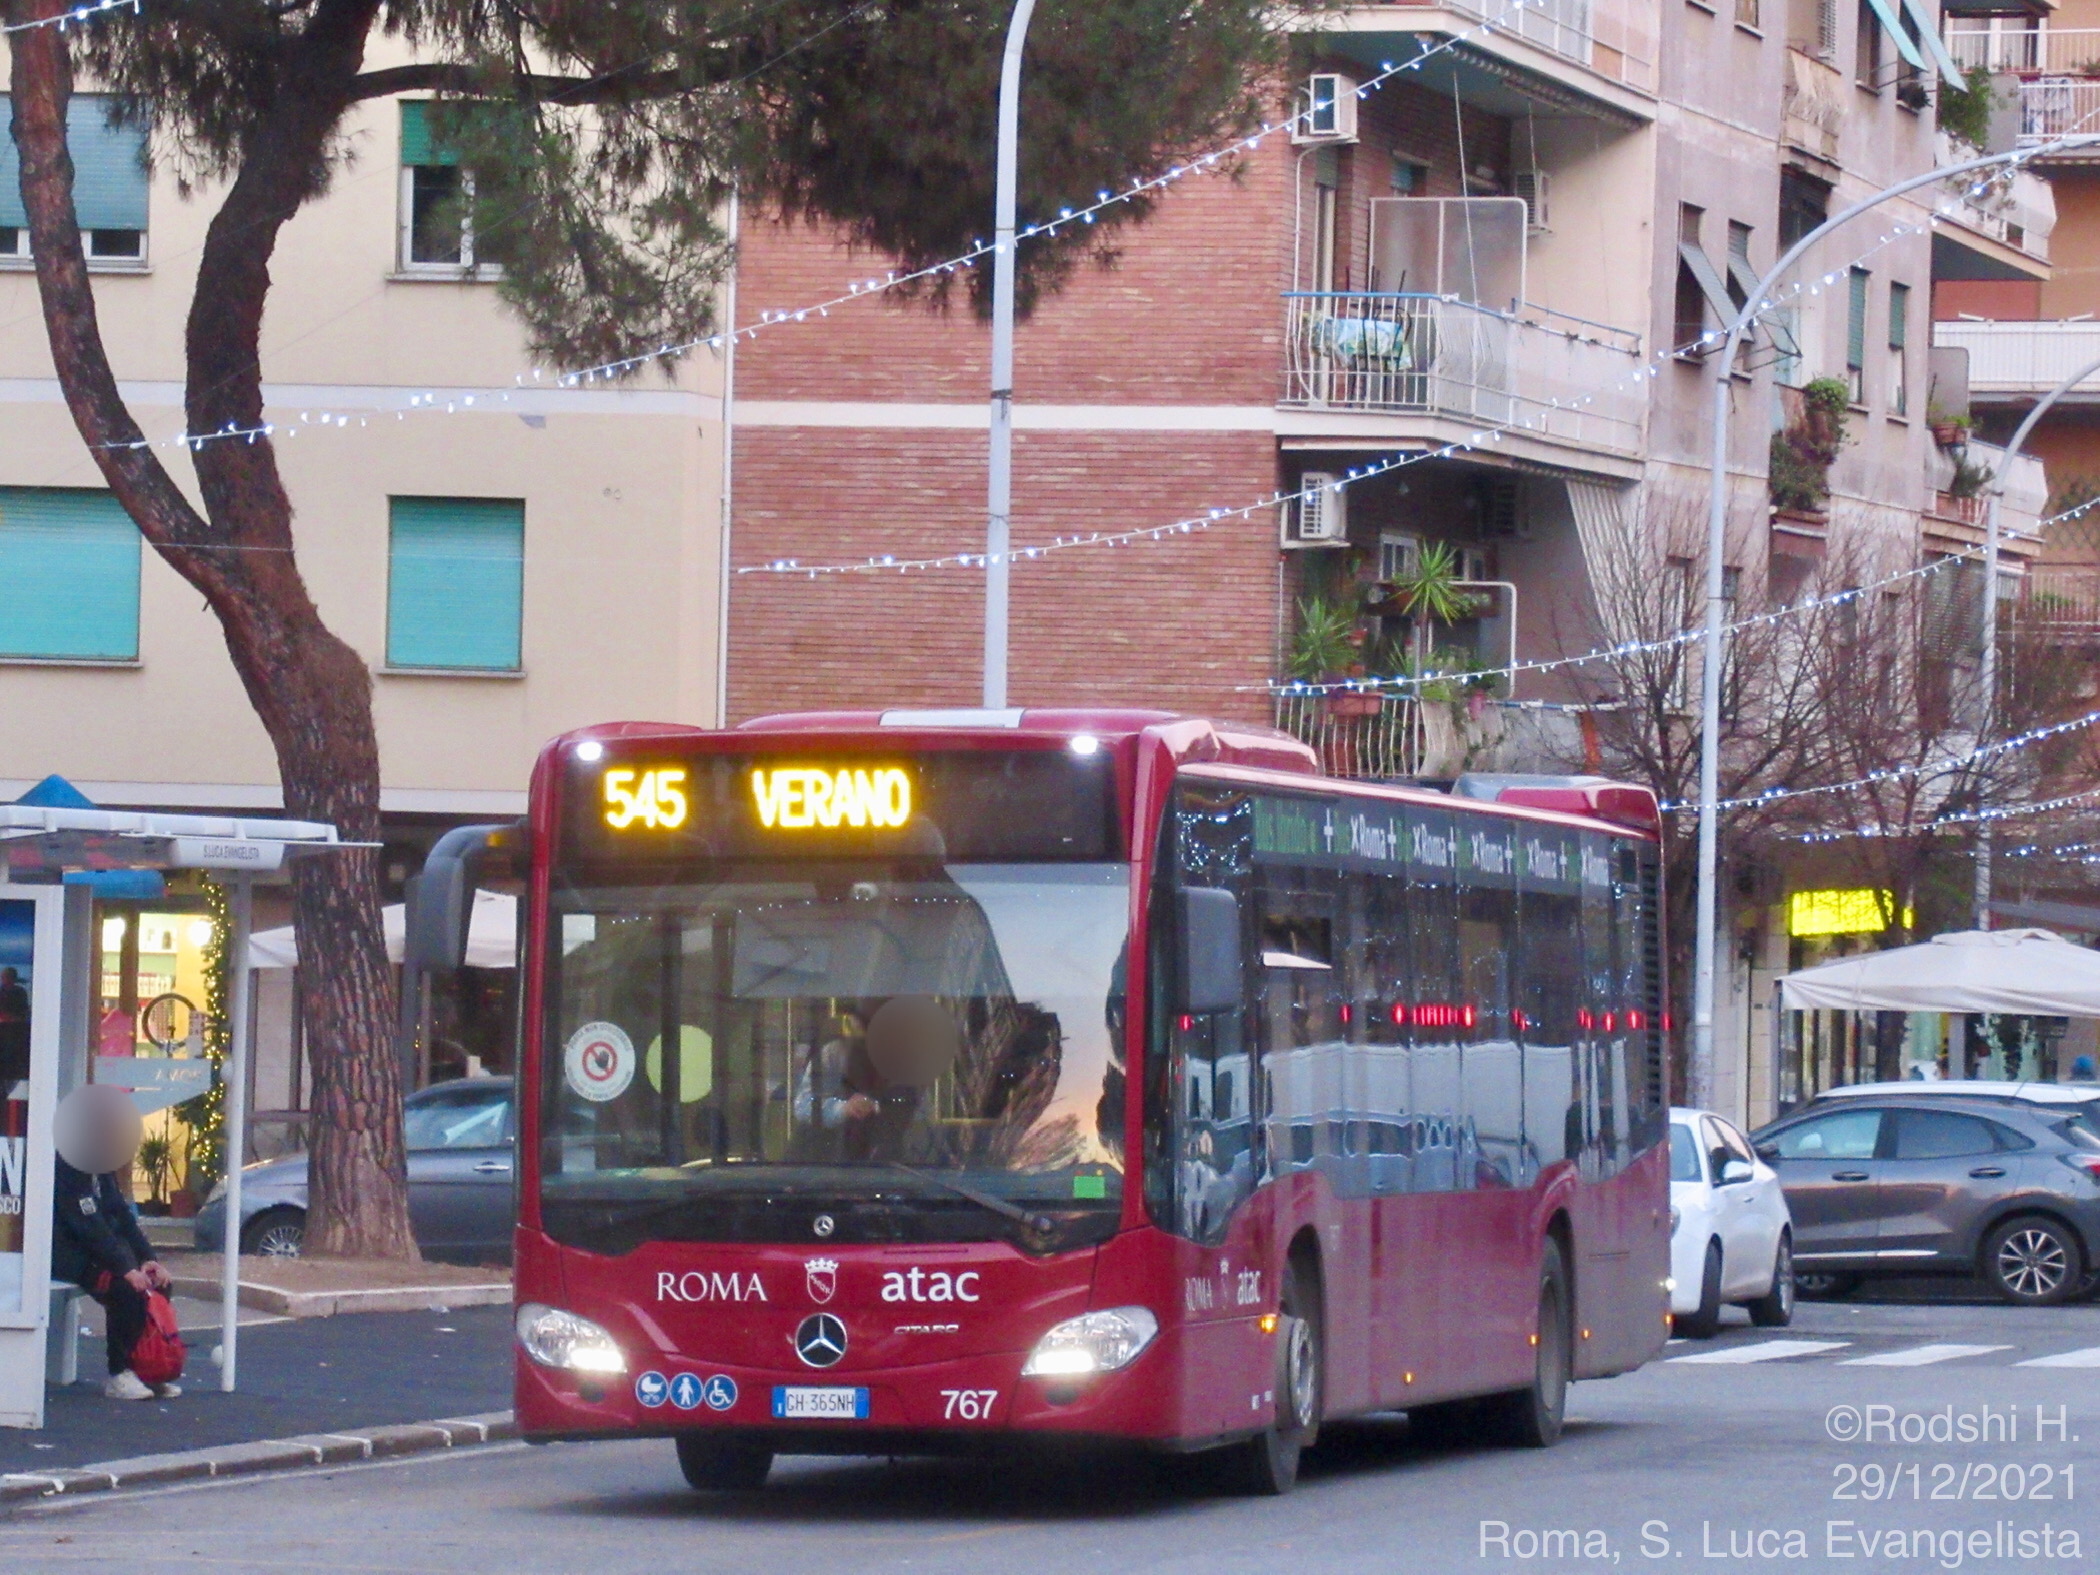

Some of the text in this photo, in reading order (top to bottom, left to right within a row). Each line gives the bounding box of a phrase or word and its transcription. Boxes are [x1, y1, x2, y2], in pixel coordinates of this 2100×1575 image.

[604, 768, 912, 829] 545 VERANO
[656, 1272, 769, 1302] ROMA
[880, 1265, 981, 1303] atac
[940, 1389, 999, 1420] 767
